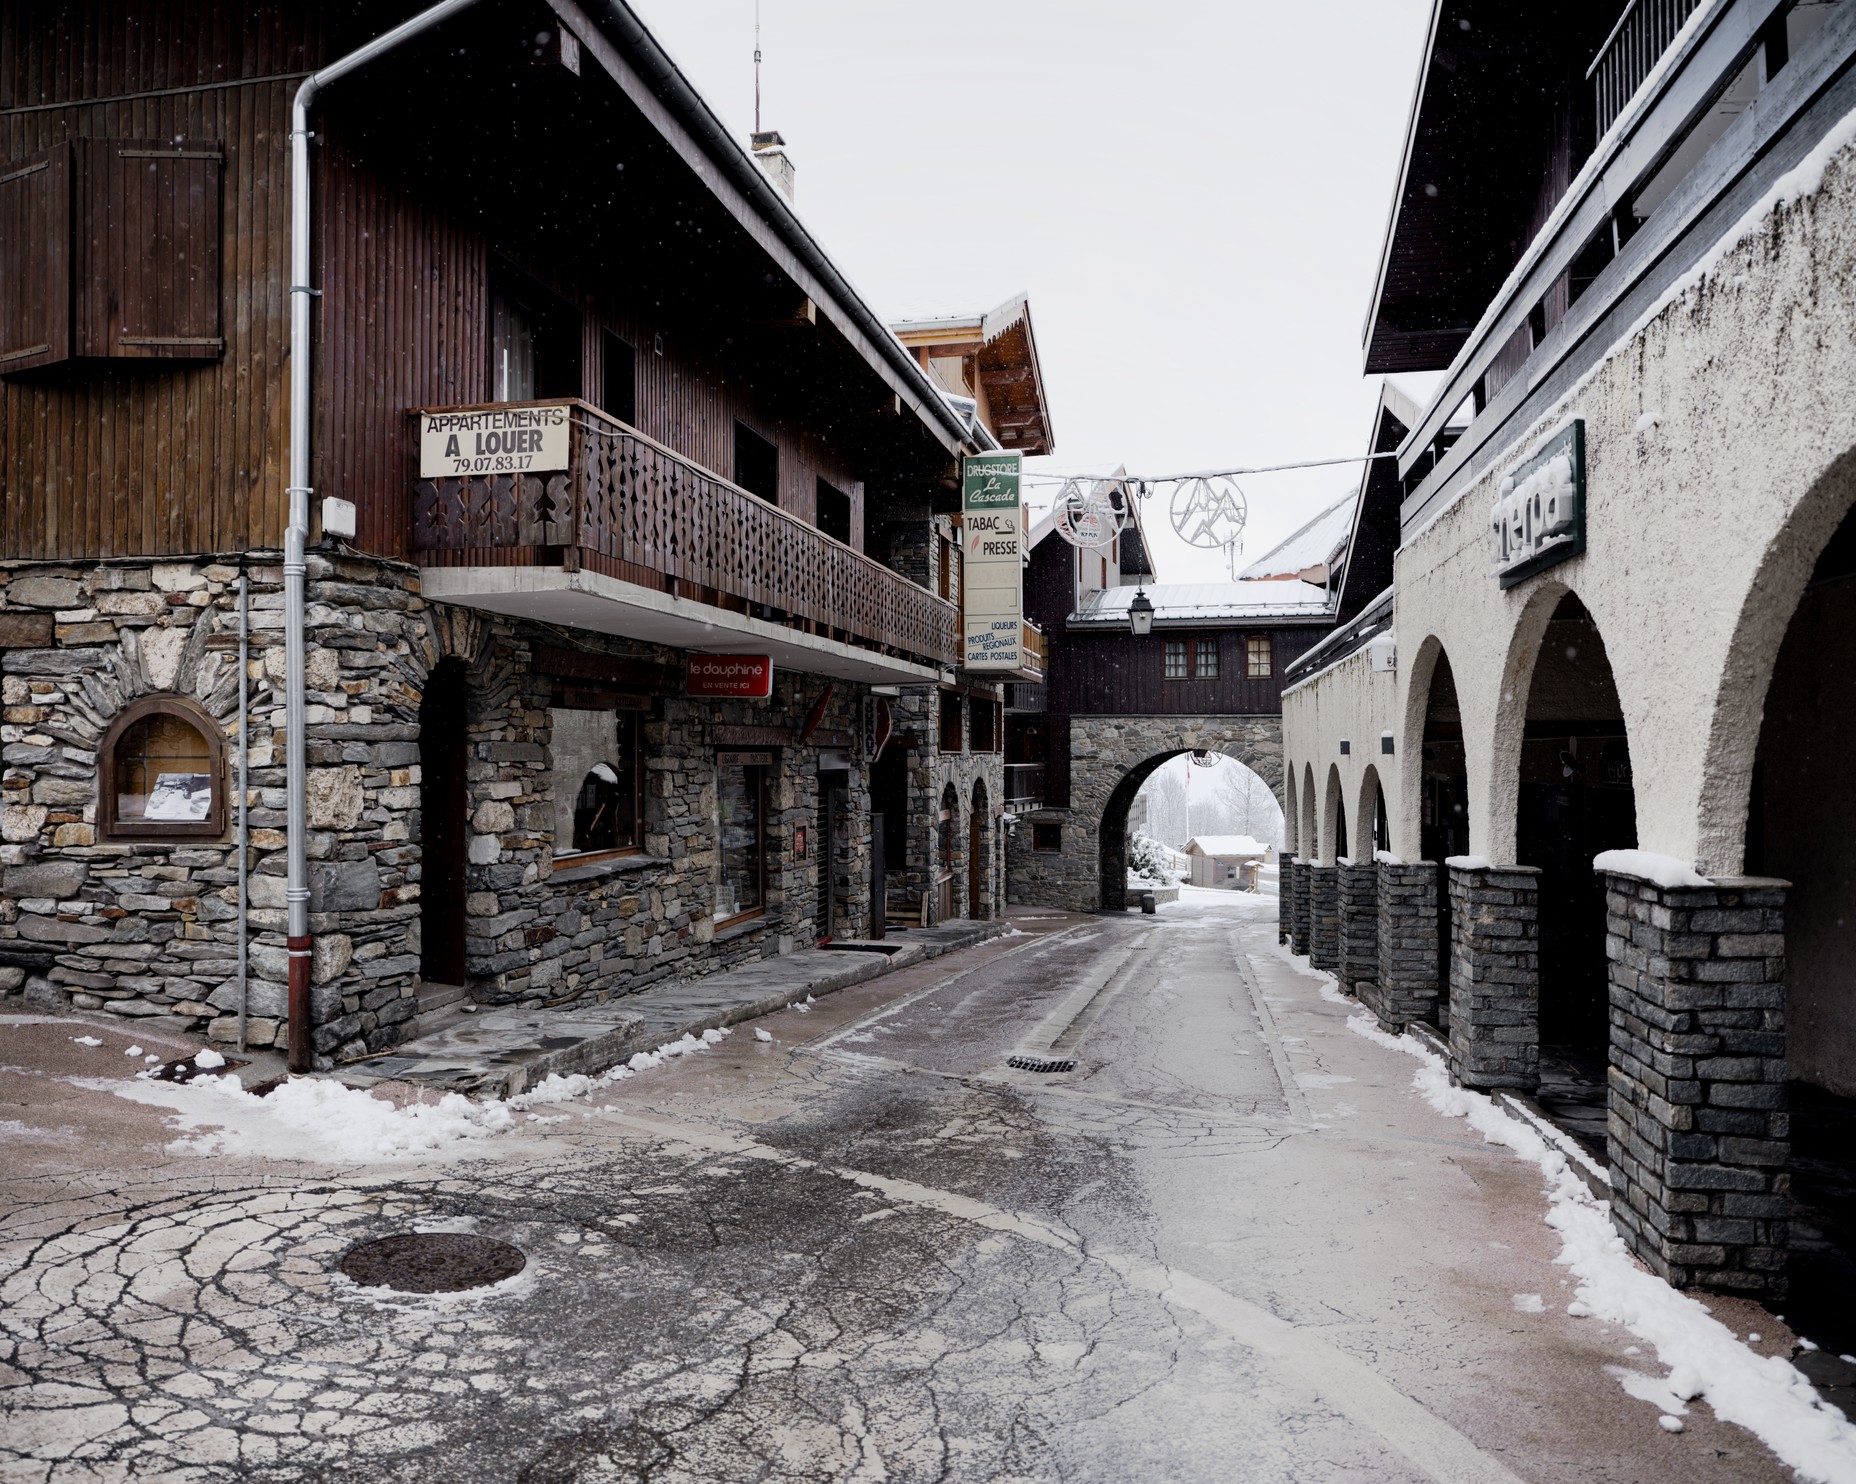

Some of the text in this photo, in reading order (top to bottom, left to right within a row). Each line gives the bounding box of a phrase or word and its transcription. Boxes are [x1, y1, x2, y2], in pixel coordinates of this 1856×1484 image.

[427, 409, 564, 433] APPARTEMENTS
[444, 429, 543, 457] A LOUER
[453, 455, 533, 473] 79.07.83.17
[967, 463, 1017, 477] DRUGSTORE
[983, 477, 1001, 492] La
[969, 488, 1015, 503] Cascade
[967, 516, 1000, 531] TABAC
[983, 541, 1017, 555] PRESSE
[991, 621, 1018, 630] LIQUEURS
[967, 632, 995, 645] PRODUITS
[967, 652, 1018, 661] CARTES POSTALES
[690, 662, 701, 674] le
[864, 698, 874, 756] JOURNAUX
